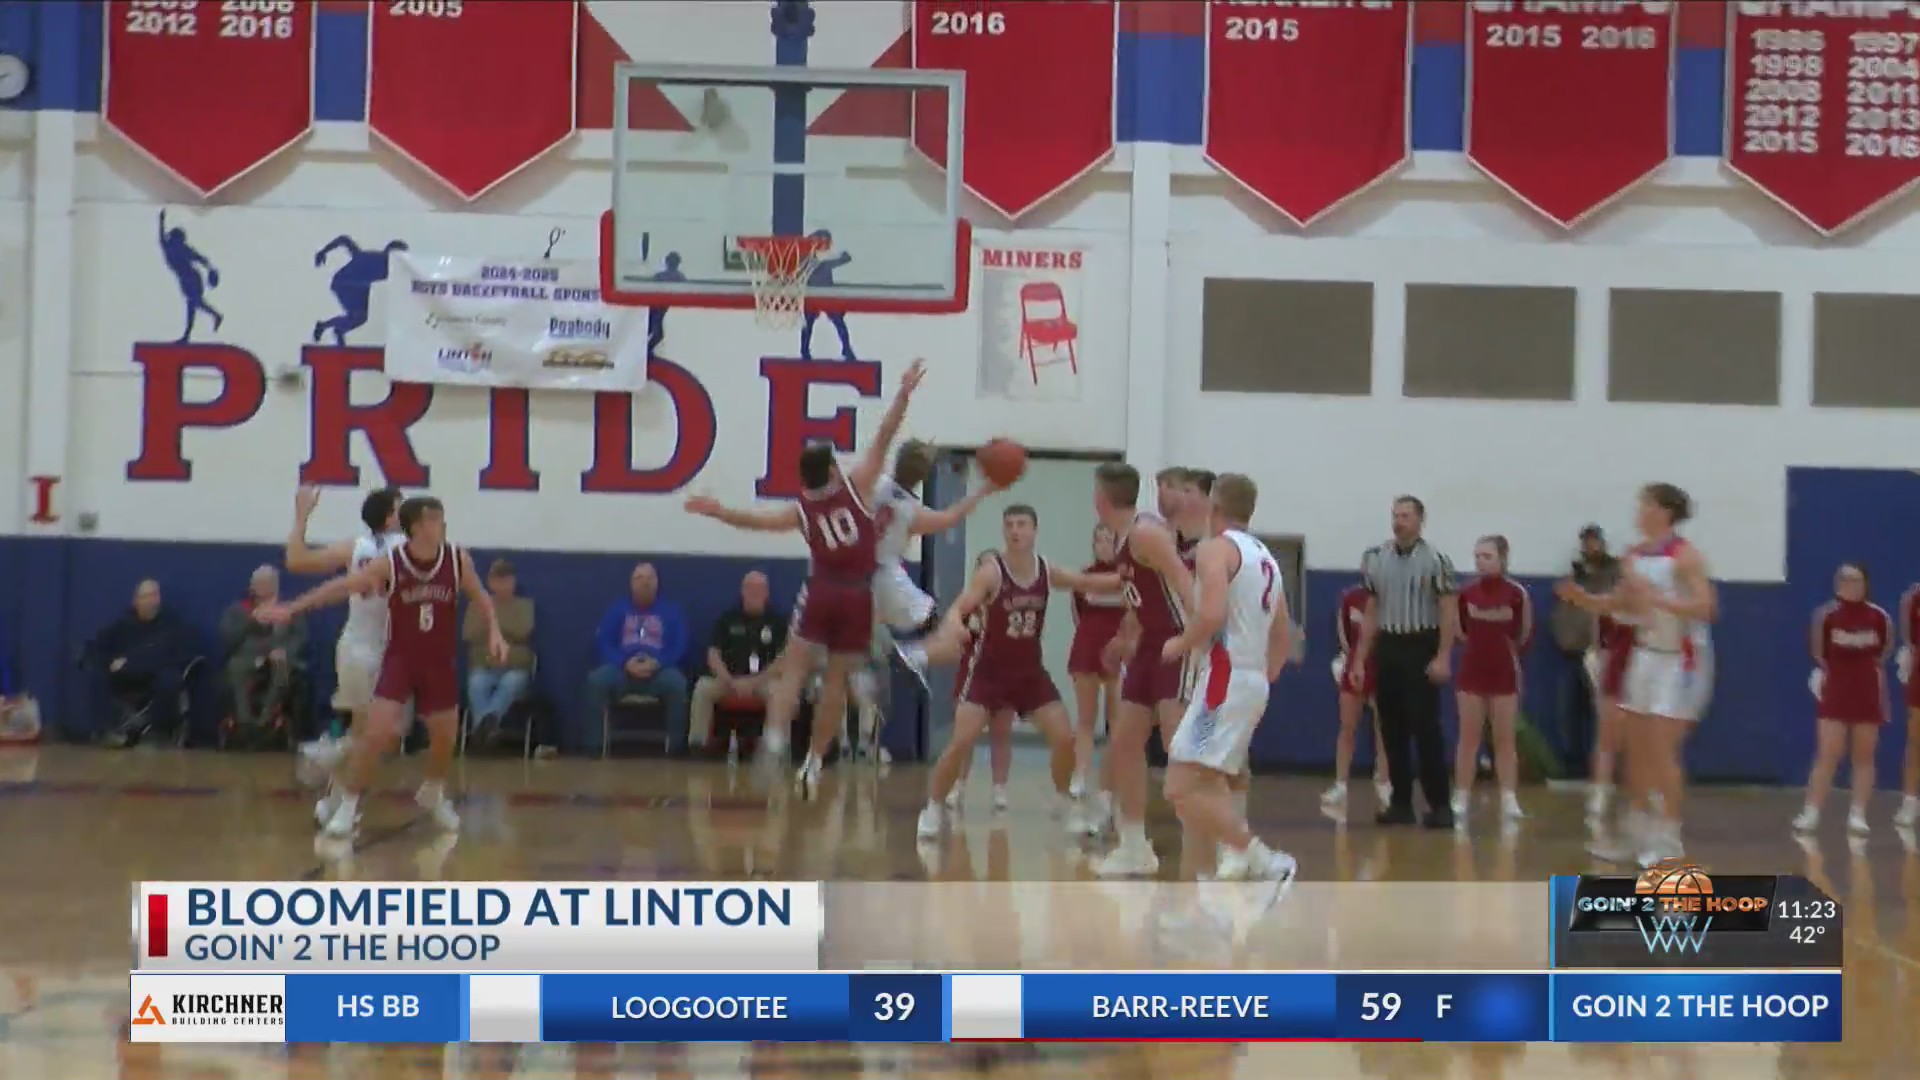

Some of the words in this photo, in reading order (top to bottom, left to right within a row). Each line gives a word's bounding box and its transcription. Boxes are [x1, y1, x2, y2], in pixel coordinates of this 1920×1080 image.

[126, 11, 197, 36] 2012
[219, 15, 293, 38] 2016
[931, 11, 1006, 35] 2016
[1225, 17, 1299, 41] 2015
[1486, 24, 1562, 47] 2015
[1744, 130, 1818, 153] 2015
[982, 249, 1083, 269] MINERS
[549, 316, 611, 339] Peabody
[127, 342, 882, 500] PRIDE
[817, 507, 860, 551] 10
